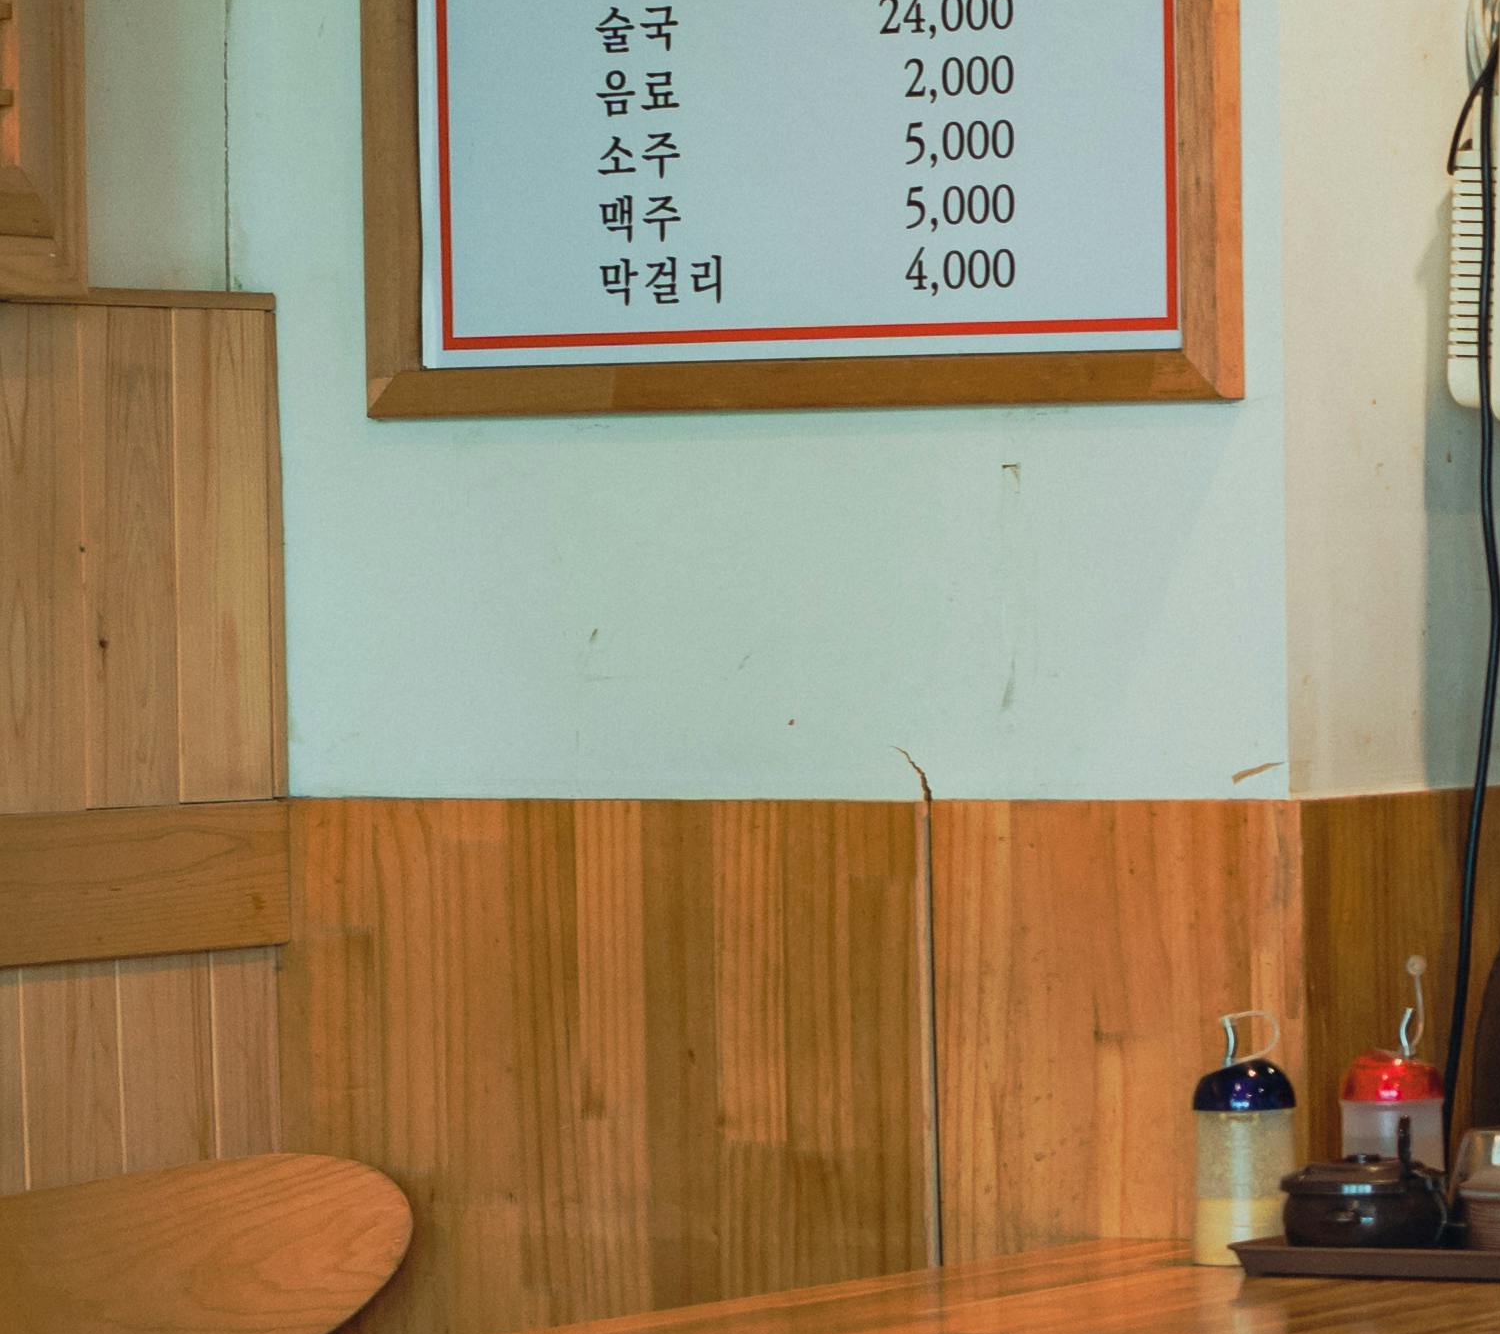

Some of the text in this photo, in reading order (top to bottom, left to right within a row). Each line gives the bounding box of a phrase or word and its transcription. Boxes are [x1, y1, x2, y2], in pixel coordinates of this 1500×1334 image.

[595, 3, 680, 54] 술국
[596, 55, 1015, 117] 음료 2,000
[597, 119, 1016, 181] 소주 5,000
[599, 184, 1016, 244] 맥주 5,000
[600, 249, 1017, 307] 막걸리 4,000
